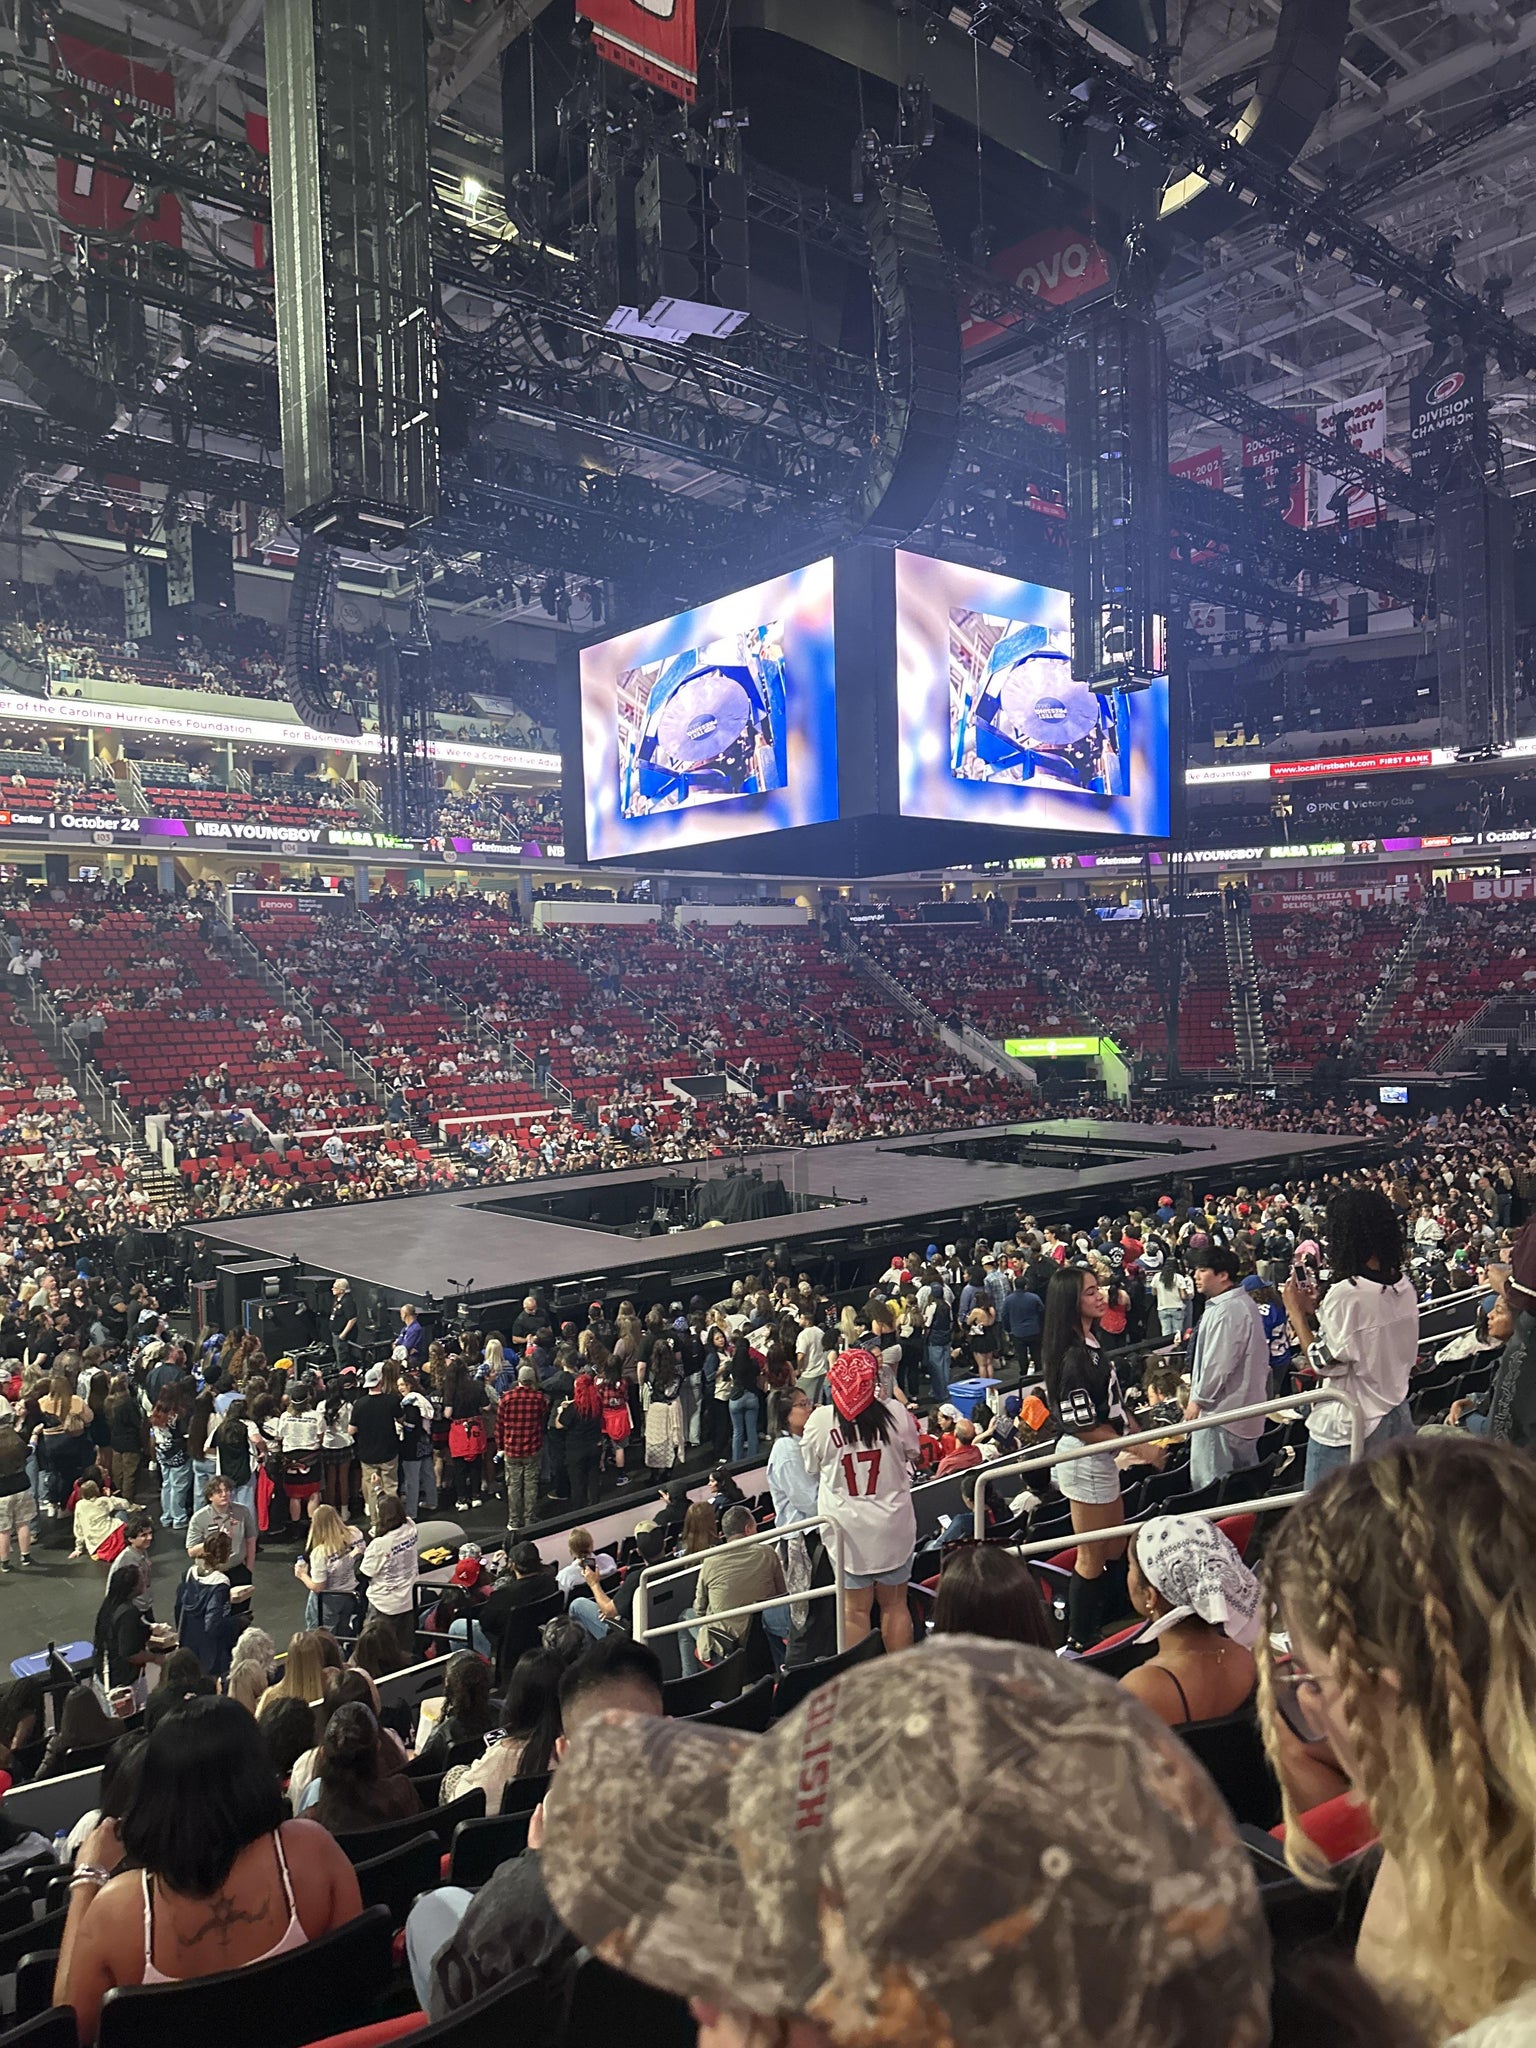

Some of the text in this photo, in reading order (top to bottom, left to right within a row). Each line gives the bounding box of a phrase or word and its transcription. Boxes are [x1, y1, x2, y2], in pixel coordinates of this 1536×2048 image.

[1419, 396, 1474, 426] DIVISION
[16, 701, 30, 711] of
[33, 703, 56, 715] the
[60, 706, 112, 720] Carolina
[117, 712, 183, 728] Hurricanes
[187, 719, 253, 735] Foundation
[283, 729, 302, 740] For
[304, 732, 363, 747] Businesses
[364, 738, 375, 748] in
[447, 747, 472, 759] We're
[482, 751, 537, 767] Competitive
[539, 756, 562, 769] Adva
[1274, 754, 1428, 776] www.localfirstbank.com FIRST BANK
[1203, 769, 1253, 780] Advantage
[1319, 796, 1415, 811] PNC Victory Club
[11, 814, 44, 825] Center
[61, 814, 140, 832] October 24
[96, 833, 111, 842] 103
[195, 821, 321, 843] NBA YOUNGBOY
[1486, 828, 1531, 843] October
[283, 844, 297, 853] 104
[472, 842, 522, 855] ticketmaster
[1423, 835, 1474, 847] Lenovo Center
[547, 844, 565, 858] NB
[1193, 846, 1264, 863] YOUNGBOY
[1309, 842, 1346, 857] TOUR
[1013, 857, 1047, 870] TOUR
[1096, 855, 1143, 866] ticketmaster
[1313, 870, 1337, 883] THE
[1282, 894, 1316, 902] WINGS,
[1317, 892, 1344, 900] PIZZA
[1356, 886, 1410, 907] THE
[1473, 879, 1536, 900] BUF
[261, 900, 293, 910] Lenovo
[841, 1449, 882, 1497] 17
